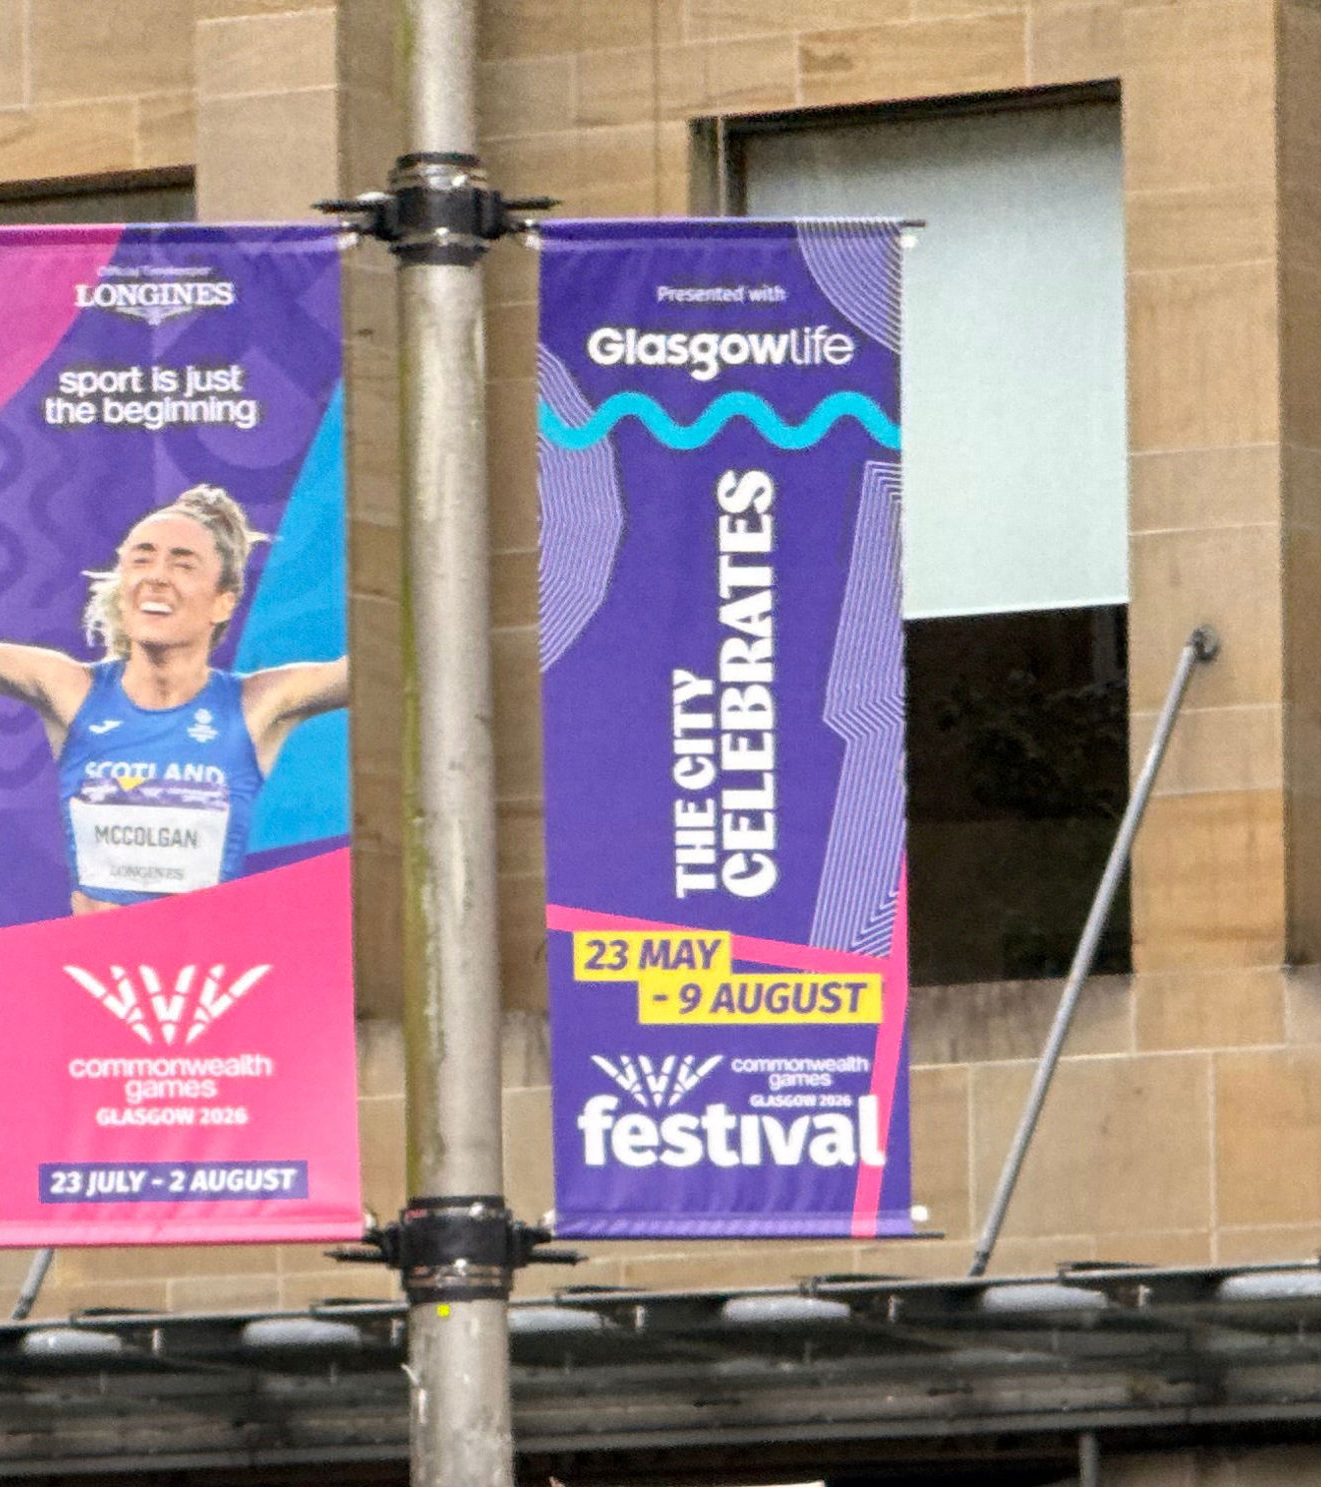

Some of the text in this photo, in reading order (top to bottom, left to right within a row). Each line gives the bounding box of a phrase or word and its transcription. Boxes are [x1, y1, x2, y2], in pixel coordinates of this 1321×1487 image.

[74, 282, 235, 308] LONGINES
[656, 285, 787, 302] Presented with
[59, 364, 243, 399] sport is just
[44, 397, 259, 430] the beginning
[716, 469, 777, 899] CELEBRATES
[671, 668, 716, 899] THE CITY
[94, 824, 198, 850] MCCOLGAN
[585, 938, 722, 971] 23 MAY
[680, 982, 701, 1015] 9
[710, 981, 868, 1015] AUGUST
[68, 1054, 273, 1079] commonwealth
[731, 1056, 870, 1074] commonwealth
[125, 1079, 218, 1105] games
[768, 1072, 832, 1090] games
[749, 1093, 852, 1108] GLASGOW 2026
[95, 1107, 249, 1127] GLASGOW 2026
[577, 1093, 886, 1167] festival
[49, 1172, 82, 1194] 23
[87, 1170, 147, 1197] JULY
[170, 1171, 185, 1192] 2
[190, 1168, 298, 1192] AUGUST
